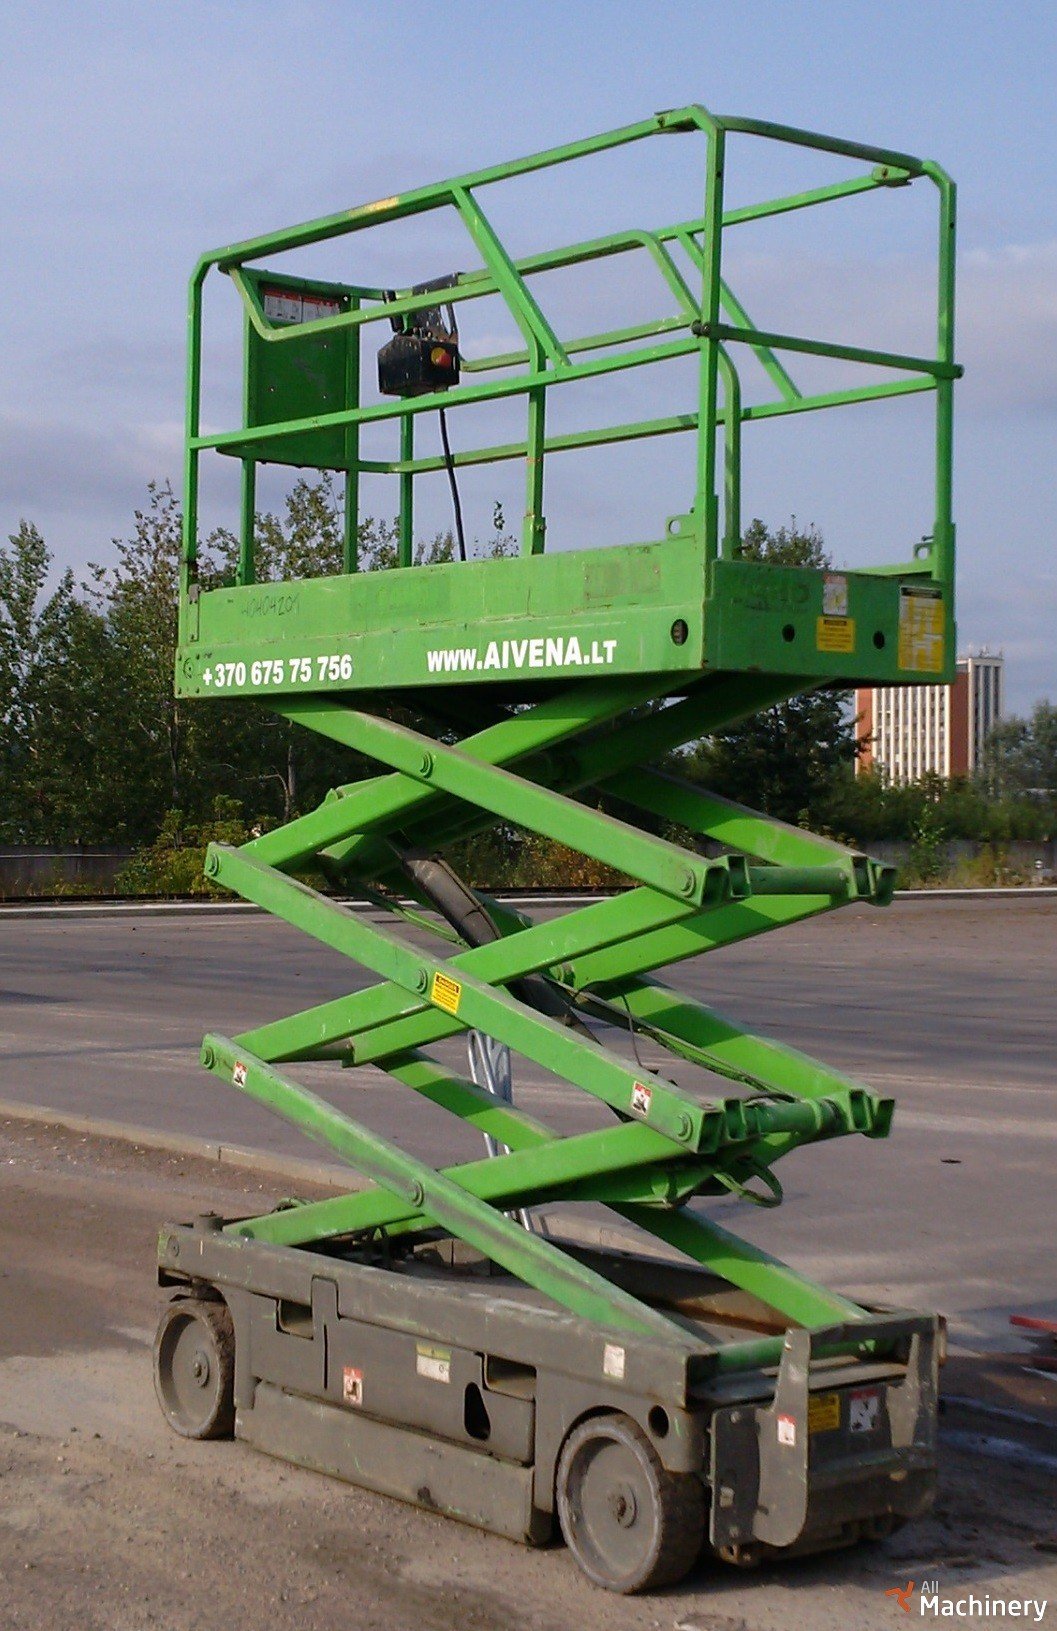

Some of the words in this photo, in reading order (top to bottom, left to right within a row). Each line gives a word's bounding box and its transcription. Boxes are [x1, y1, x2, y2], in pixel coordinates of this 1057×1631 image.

[202, 662, 246, 688] +370
[251, 660, 284, 685] 675
[289, 657, 312, 682] 75
[317, 654, 353, 681] 756
